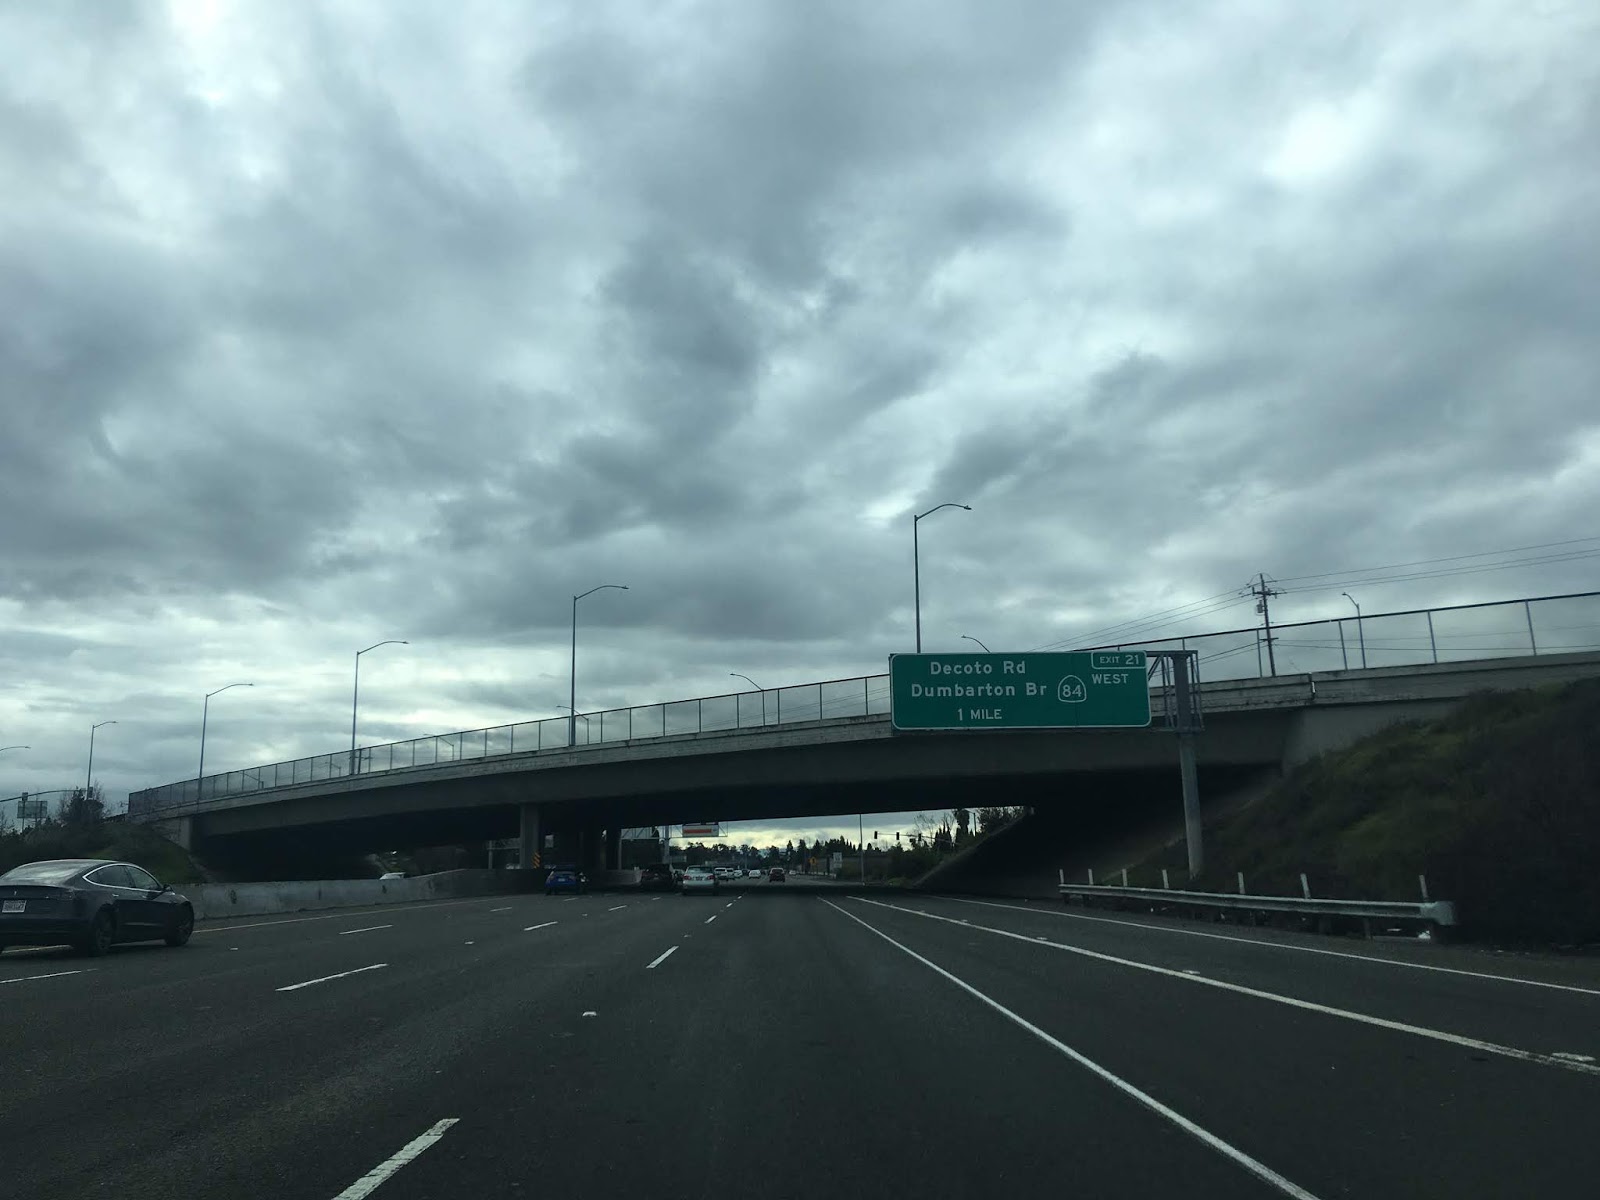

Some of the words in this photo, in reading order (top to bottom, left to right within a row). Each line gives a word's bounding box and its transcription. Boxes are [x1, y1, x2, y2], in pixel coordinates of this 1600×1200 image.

[1099, 656, 1120, 664] EXIT
[1125, 654, 1139, 665] 21
[930, 661, 992, 675] Decoto
[1003, 660, 1026, 674] Rd
[1091, 673, 1129, 684] WEST
[911, 682, 1014, 697] Dumbarton
[1026, 682, 1047, 696] Br
[1062, 684, 1082, 698] 84
[957, 709, 963, 721] 1
[970, 708, 1002, 720] MILE
